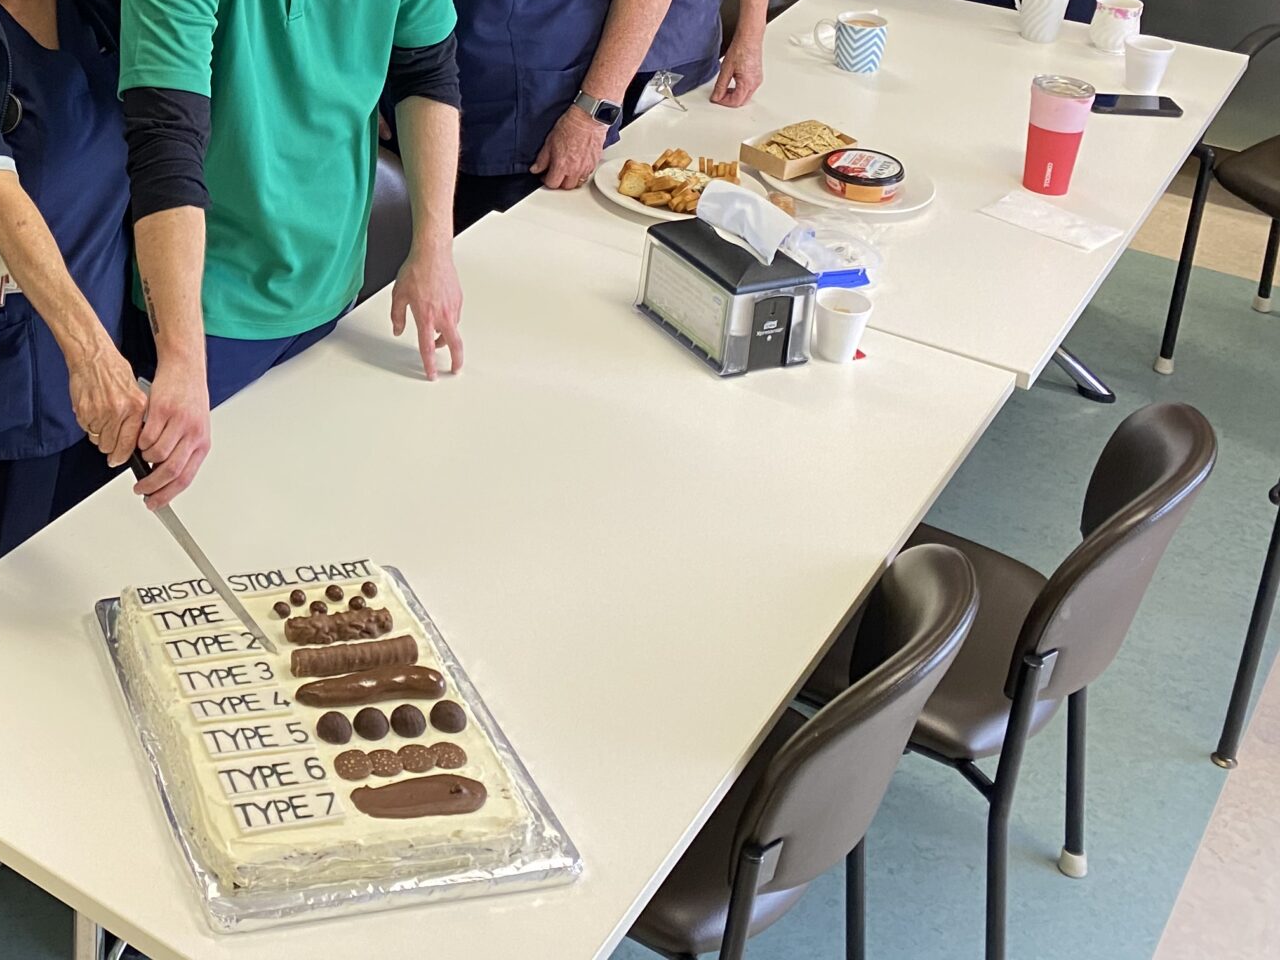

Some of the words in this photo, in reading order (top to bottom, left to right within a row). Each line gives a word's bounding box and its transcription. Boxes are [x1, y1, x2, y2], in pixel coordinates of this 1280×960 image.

[136, 578, 216, 605] BRISTO
[227, 569, 298, 593] STOOL
[295, 559, 374, 583] CHART
[153, 603, 224, 630] TYPE
[165, 633, 238, 659] TYPE
[240, 632, 262, 651] 2
[178, 664, 252, 691] TYPE
[254, 661, 275, 681] 3
[190, 693, 266, 717] TYPE
[273, 691, 292, 707] 4
[202, 725, 279, 753] TYPE
[285, 721, 309, 743] 5
[217, 762, 300, 794] TYPE
[304, 756, 327, 781] 6
[233, 794, 314, 828] TYPE
[315, 791, 335, 816] 7
